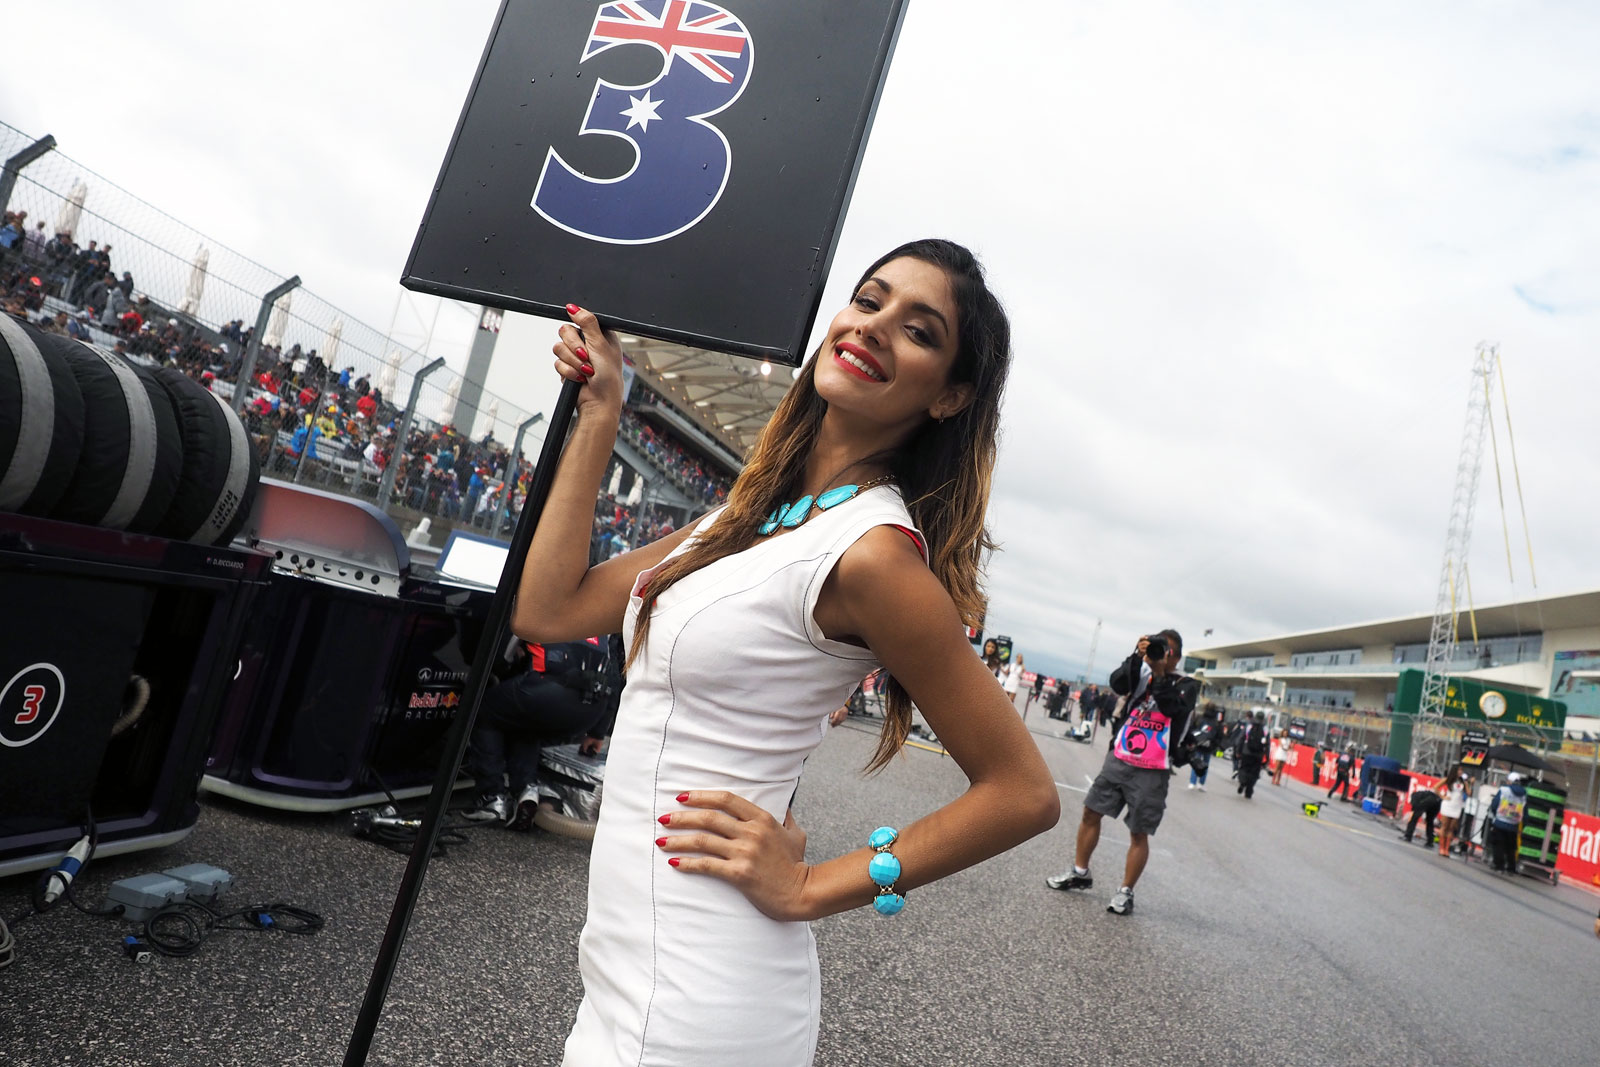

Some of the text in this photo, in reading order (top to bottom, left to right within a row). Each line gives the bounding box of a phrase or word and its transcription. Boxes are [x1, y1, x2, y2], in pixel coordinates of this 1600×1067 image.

[530, 0, 755, 245] 3
[15, 685, 46, 724] 3
[405, 711, 456, 719] RACING
